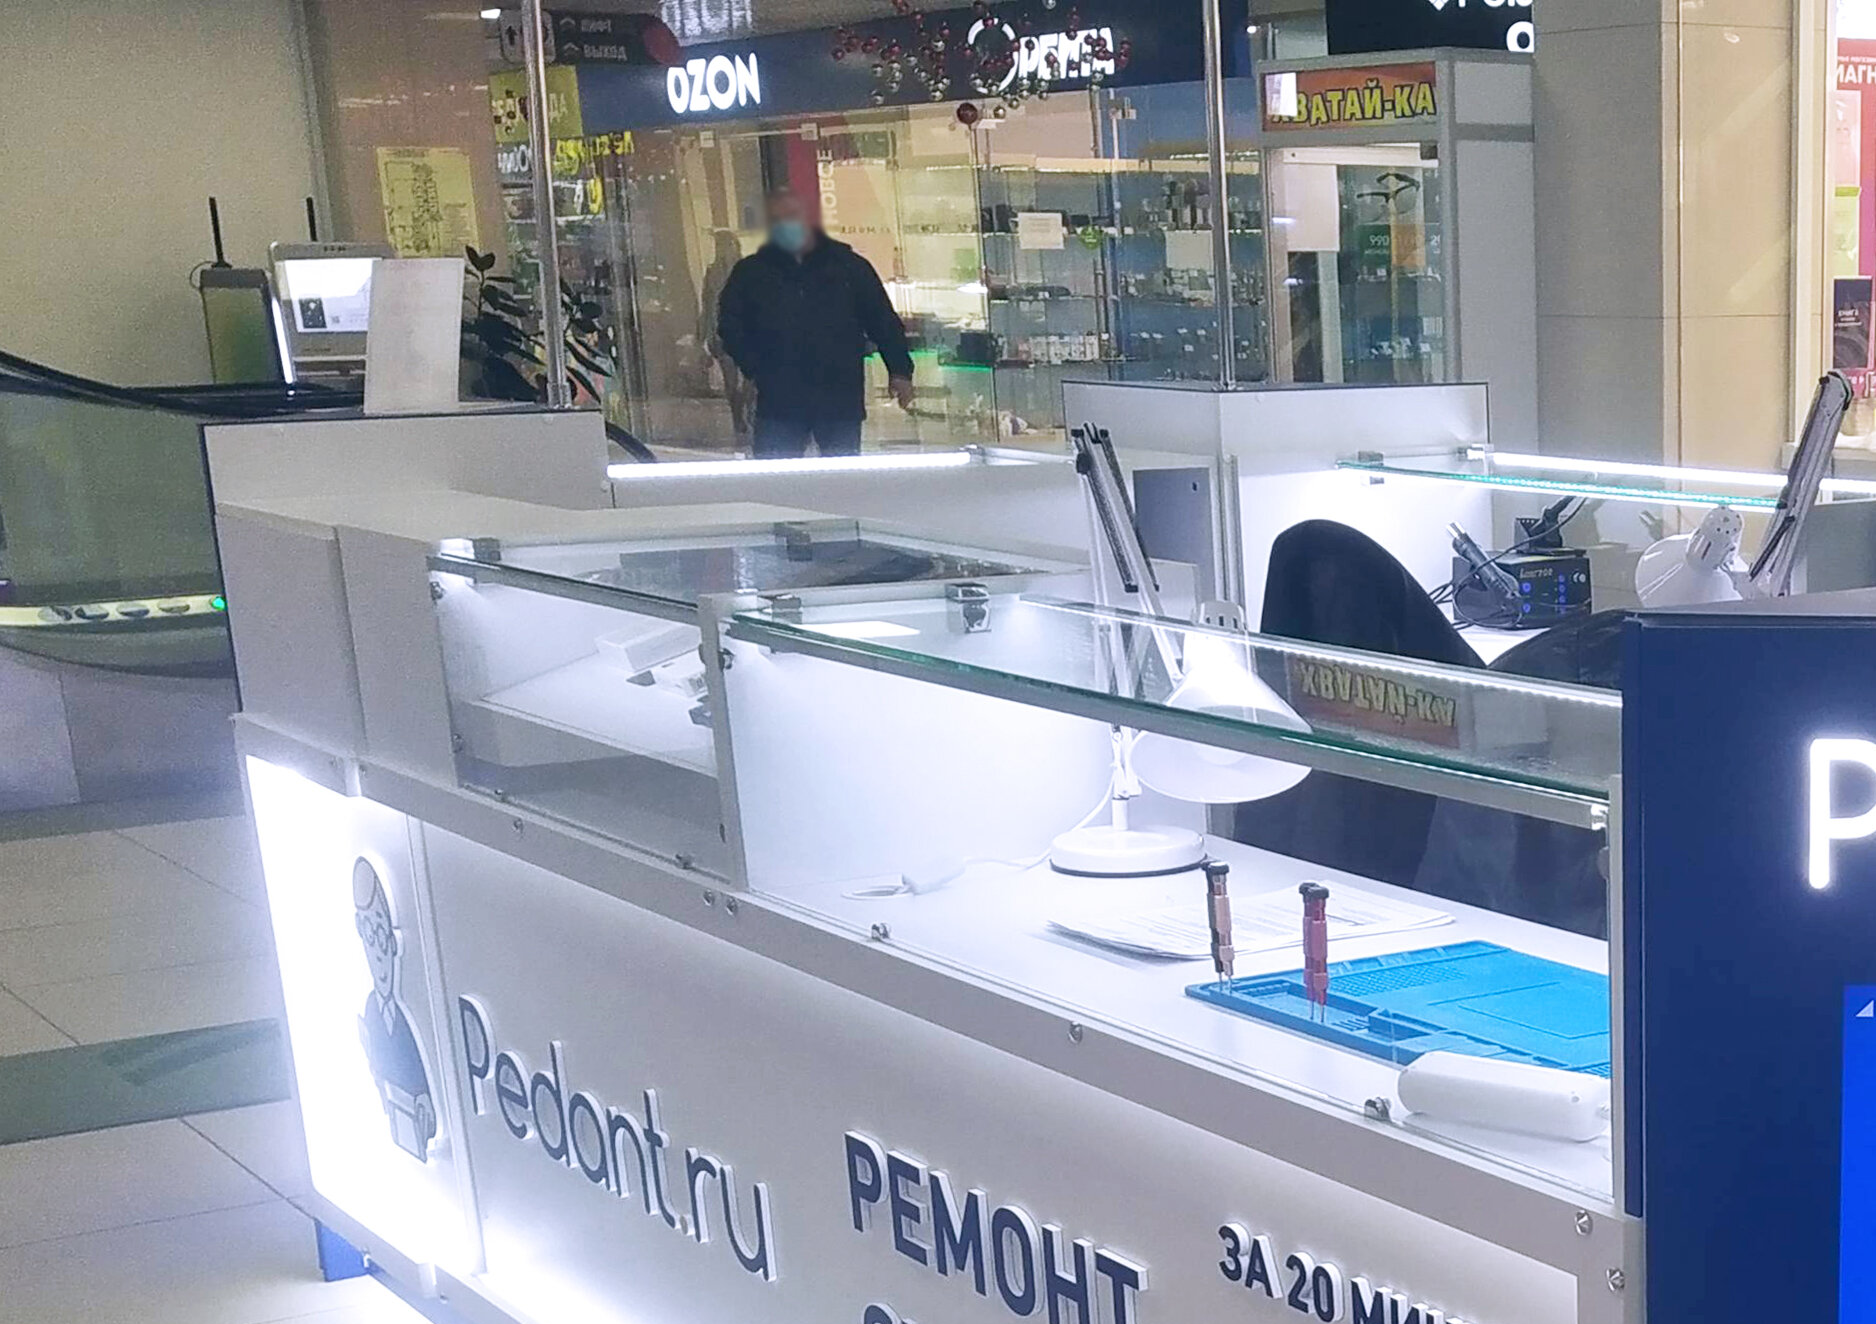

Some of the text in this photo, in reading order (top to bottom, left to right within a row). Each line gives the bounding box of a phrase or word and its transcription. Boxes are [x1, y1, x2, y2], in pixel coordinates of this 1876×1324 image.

[666, 53, 761, 114] OZON
[459, 994, 777, 1282] Pedant.ru
[1217, 1222, 1283, 1299] ЗА
[1285, 1251, 1345, 1323] 20
